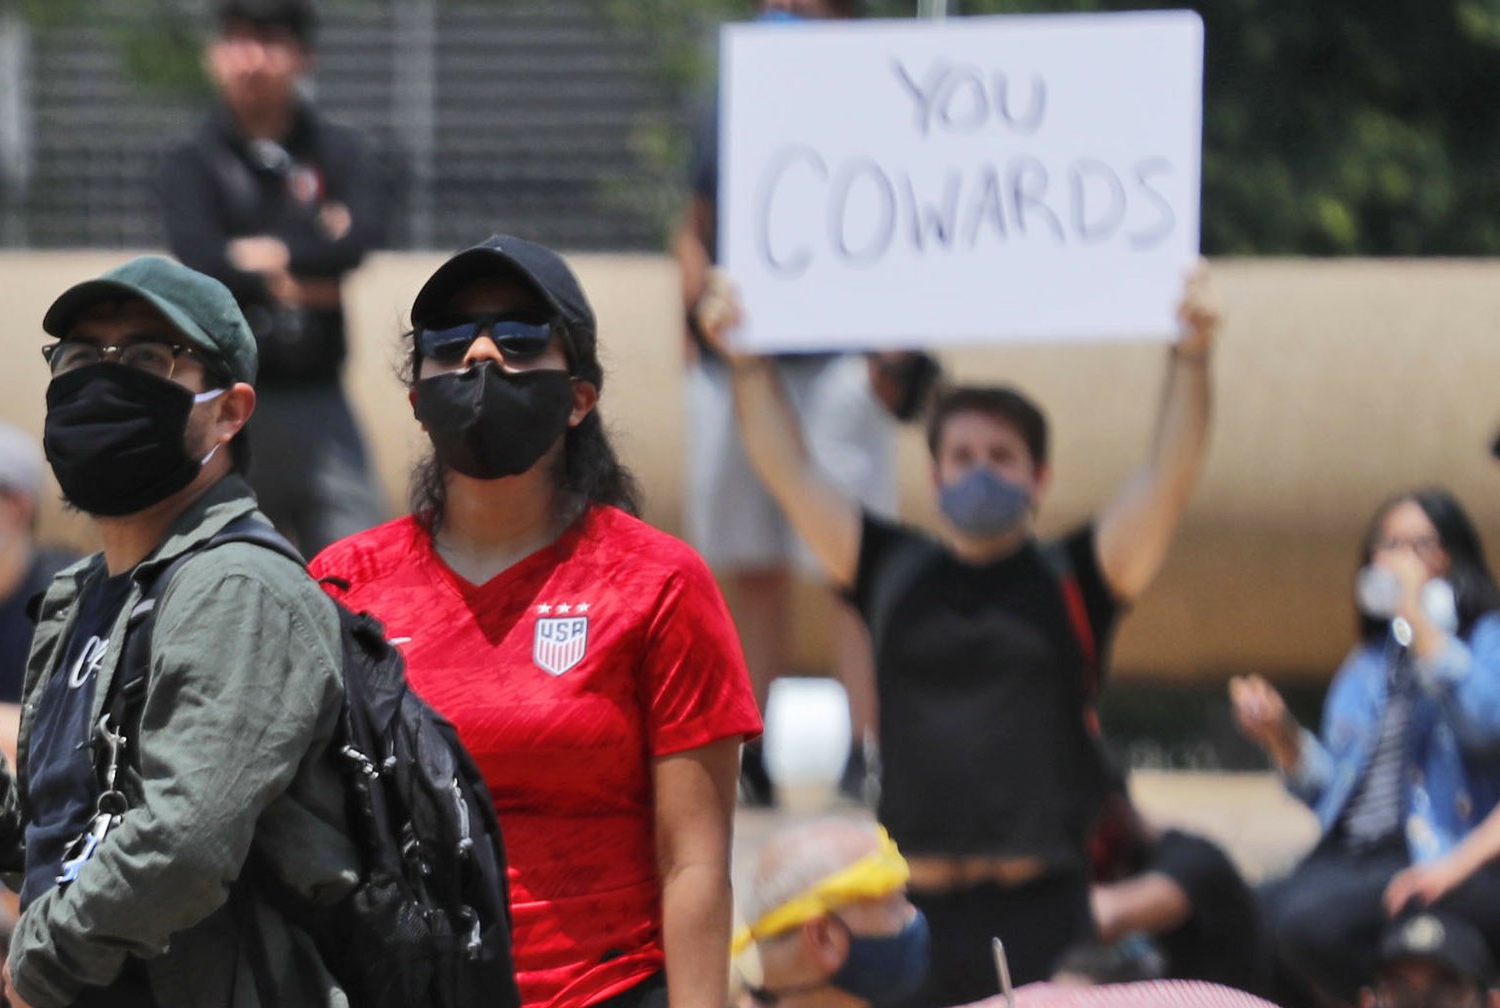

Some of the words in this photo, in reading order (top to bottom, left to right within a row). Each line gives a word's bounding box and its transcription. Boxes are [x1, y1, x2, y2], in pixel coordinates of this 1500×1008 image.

[890, 54, 1047, 138] YOU
[754, 142, 1177, 280] COWARDS
[541, 620, 585, 642] USA
